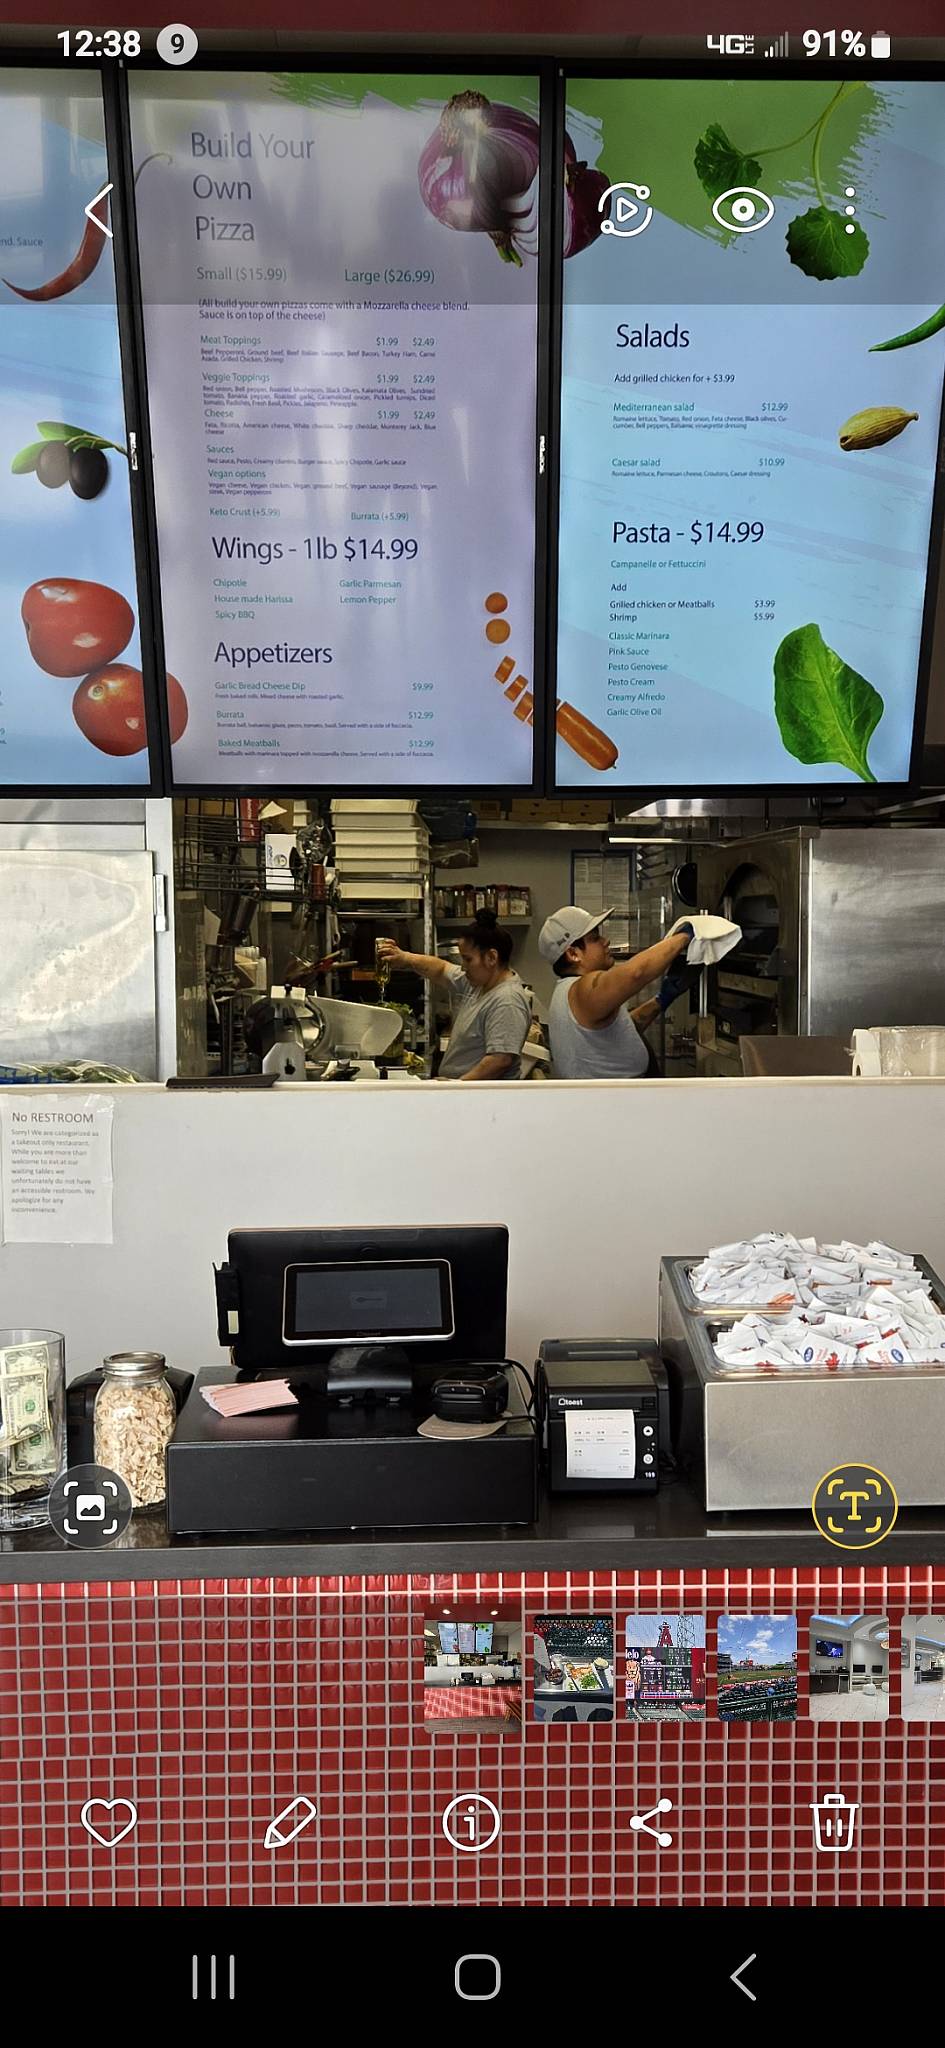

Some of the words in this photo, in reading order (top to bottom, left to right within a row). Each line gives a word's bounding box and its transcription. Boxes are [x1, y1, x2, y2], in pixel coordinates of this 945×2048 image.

[191, 131, 251, 158] Build
[258, 132, 315, 159] Your
[192, 174, 252, 200] Own
[195, 215, 255, 241] Pizza
[196, 266, 232, 280] Small
[236, 266, 288, 282] ($15.99)
[344, 269, 380, 285] Large
[384, 269, 435, 284] ($26.99)
[198, 298, 213, 309] (All
[214, 299, 237, 308] build
[240, 301, 259, 310] your
[281, 301, 308, 311] pizzas
[335, 301, 355, 310] with
[363, 301, 409, 311] Mozzarella
[411, 301, 441, 311] cheese
[442, 301, 470, 311] blend.
[199, 310, 225, 319] Sauce
[227, 311, 234, 319] is
[248, 311, 264, 322] top
[266, 310, 274, 319] of
[277, 310, 290, 319] the
[292, 310, 326, 321] cheese)
[616, 322, 690, 348] Salads
[200, 335, 221, 344] Meat
[223, 335, 262, 346] Toppings
[376, 336, 398, 346] $1.99
[412, 337, 435, 346] $2.49
[202, 372, 231, 383] Veggie
[232, 373, 271, 384] Toppings
[377, 374, 399, 384] $1.99
[413, 374, 435, 384] $2.49
[614, 374, 631, 383] Add
[633, 374, 658, 384] grilled
[660, 374, 691, 383] chicken
[692, 374, 704, 383] for
[713, 374, 735, 383] $3.99
[613, 402, 672, 412] Mediterranean
[673, 402, 695, 412] salad
[761, 403, 788, 412] $12.99
[204, 408, 234, 417] Cheese
[377, 410, 400, 419] $1.99
[414, 410, 435, 419] $2.49
[206, 445, 234, 453] Sauces
[612, 458, 638, 467] Caesar
[639, 458, 661, 467] salad
[759, 458, 785, 467] $10.99
[208, 469, 233, 479] Vegan
[235, 470, 266, 480] options
[209, 507, 229, 516] Keto
[230, 507, 251, 516] Crust
[252, 508, 281, 517] (+5.99)
[351, 512, 380, 521] Burrata
[381, 512, 409, 522] (+5.99)
[612, 521, 671, 544] Pasta
[690, 520, 764, 545] $14.99
[211, 536, 284, 565] Wings
[303, 536, 338, 560] 1lb
[343, 536, 419, 561] $14.99
[611, 560, 657, 570] Campanelle
[668, 560, 706, 568] Fettuccini
[213, 578, 247, 589] Chipotle
[339, 579, 362, 588] Garlic
[364, 579, 402, 589] Parmesan
[611, 584, 627, 592] Add
[214, 595, 240, 603] House
[241, 595, 264, 603] made
[264, 595, 293, 604] Harissa
[340, 595, 367, 605] Lemon
[368, 596, 396, 606] Pepper
[609, 600, 635, 609] Grilled
[637, 600, 666, 609] chicken
[677, 600, 715, 609] Meatballs
[754, 600, 776, 608] $3.99
[216, 610, 236, 621] Spicy
[238, 610, 255, 620] BBQ
[609, 613, 637, 623] Shrimp
[754, 613, 775, 621] $5.99
[608, 632, 635, 640] Classic
[636, 632, 670, 640] Marinara
[214, 641, 333, 668] Appetizers
[608, 647, 625, 655] Pink
[626, 647, 649, 655] Sauce
[608, 663, 629, 671] Pesto
[630, 663, 668, 671] Genovese
[215, 682, 237, 690] Garlic
[238, 682, 260, 690] Bread
[262, 682, 290, 690] Cheese
[292, 682, 306, 691] Dip
[412, 682, 434, 691] $9.99
[608, 678, 629, 686] Pesto
[630, 678, 655, 686] Cream
[607, 694, 636, 703] Creamy
[637, 693, 665, 701] Alfredo
[216, 710, 245, 719] Burrata
[408, 711, 434, 720] $12.99
[607, 708, 629, 716] Garlic
[630, 708, 650, 716] Olive
[651, 708, 662, 716] Oil
[218, 739, 242, 747] Baked
[244, 739, 280, 748] Meatballs
[409, 739, 434, 748] $12.99
[12, 1112, 28, 1122] No
[31, 1112, 94, 1123] RESTROOM
